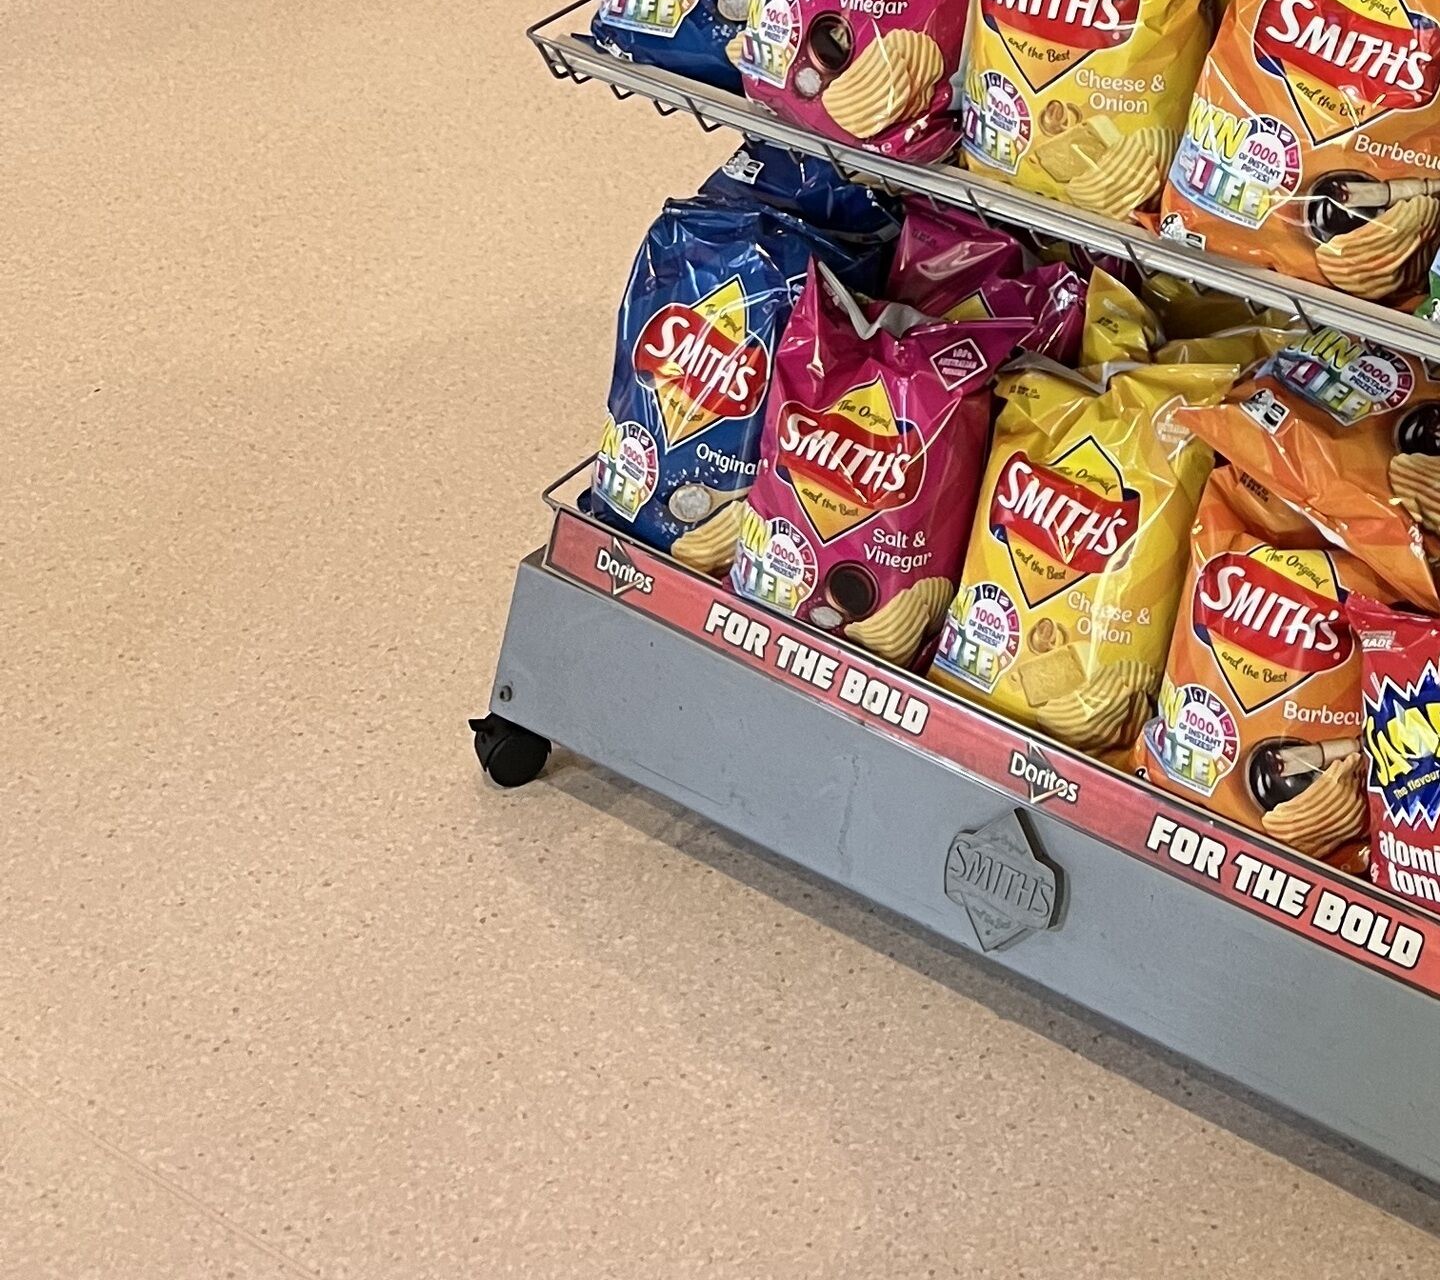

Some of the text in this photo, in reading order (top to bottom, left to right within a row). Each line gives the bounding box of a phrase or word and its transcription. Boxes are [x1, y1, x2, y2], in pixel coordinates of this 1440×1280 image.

[1075, 69, 1165, 94] Cheese &
[1089, 92, 1149, 115] Onion
[1190, 95, 1250, 159] WIN
[1250, 156, 1282, 179] INSTANT
[645, 315, 757, 403] SMITH'S
[779, 411, 911, 494] SMITH'S
[997, 461, 1129, 556] SMITH'S
[863, 543, 933, 574] Vinegar
[872, 528, 927, 549] Salt &
[1263, 545, 1326, 589] The Original
[1067, 590, 1151, 626] Cheese &
[1200, 565, 1340, 653] SMITH'S
[1076, 617, 1132, 646] Onion
[1188, 724, 1222, 749] INSTANT
[595, 547, 655, 596] Doritos
[705, 602, 767, 658] FOR
[776, 637, 835, 691] THE
[839, 667, 930, 734] BOLD
[1008, 751, 1079, 804] Doritos
[1148, 816, 1226, 880] FOR
[1235, 853, 1308, 920] THE
[1314, 892, 1425, 970] BOLD
[950, 842, 1053, 919] SMITH'S
